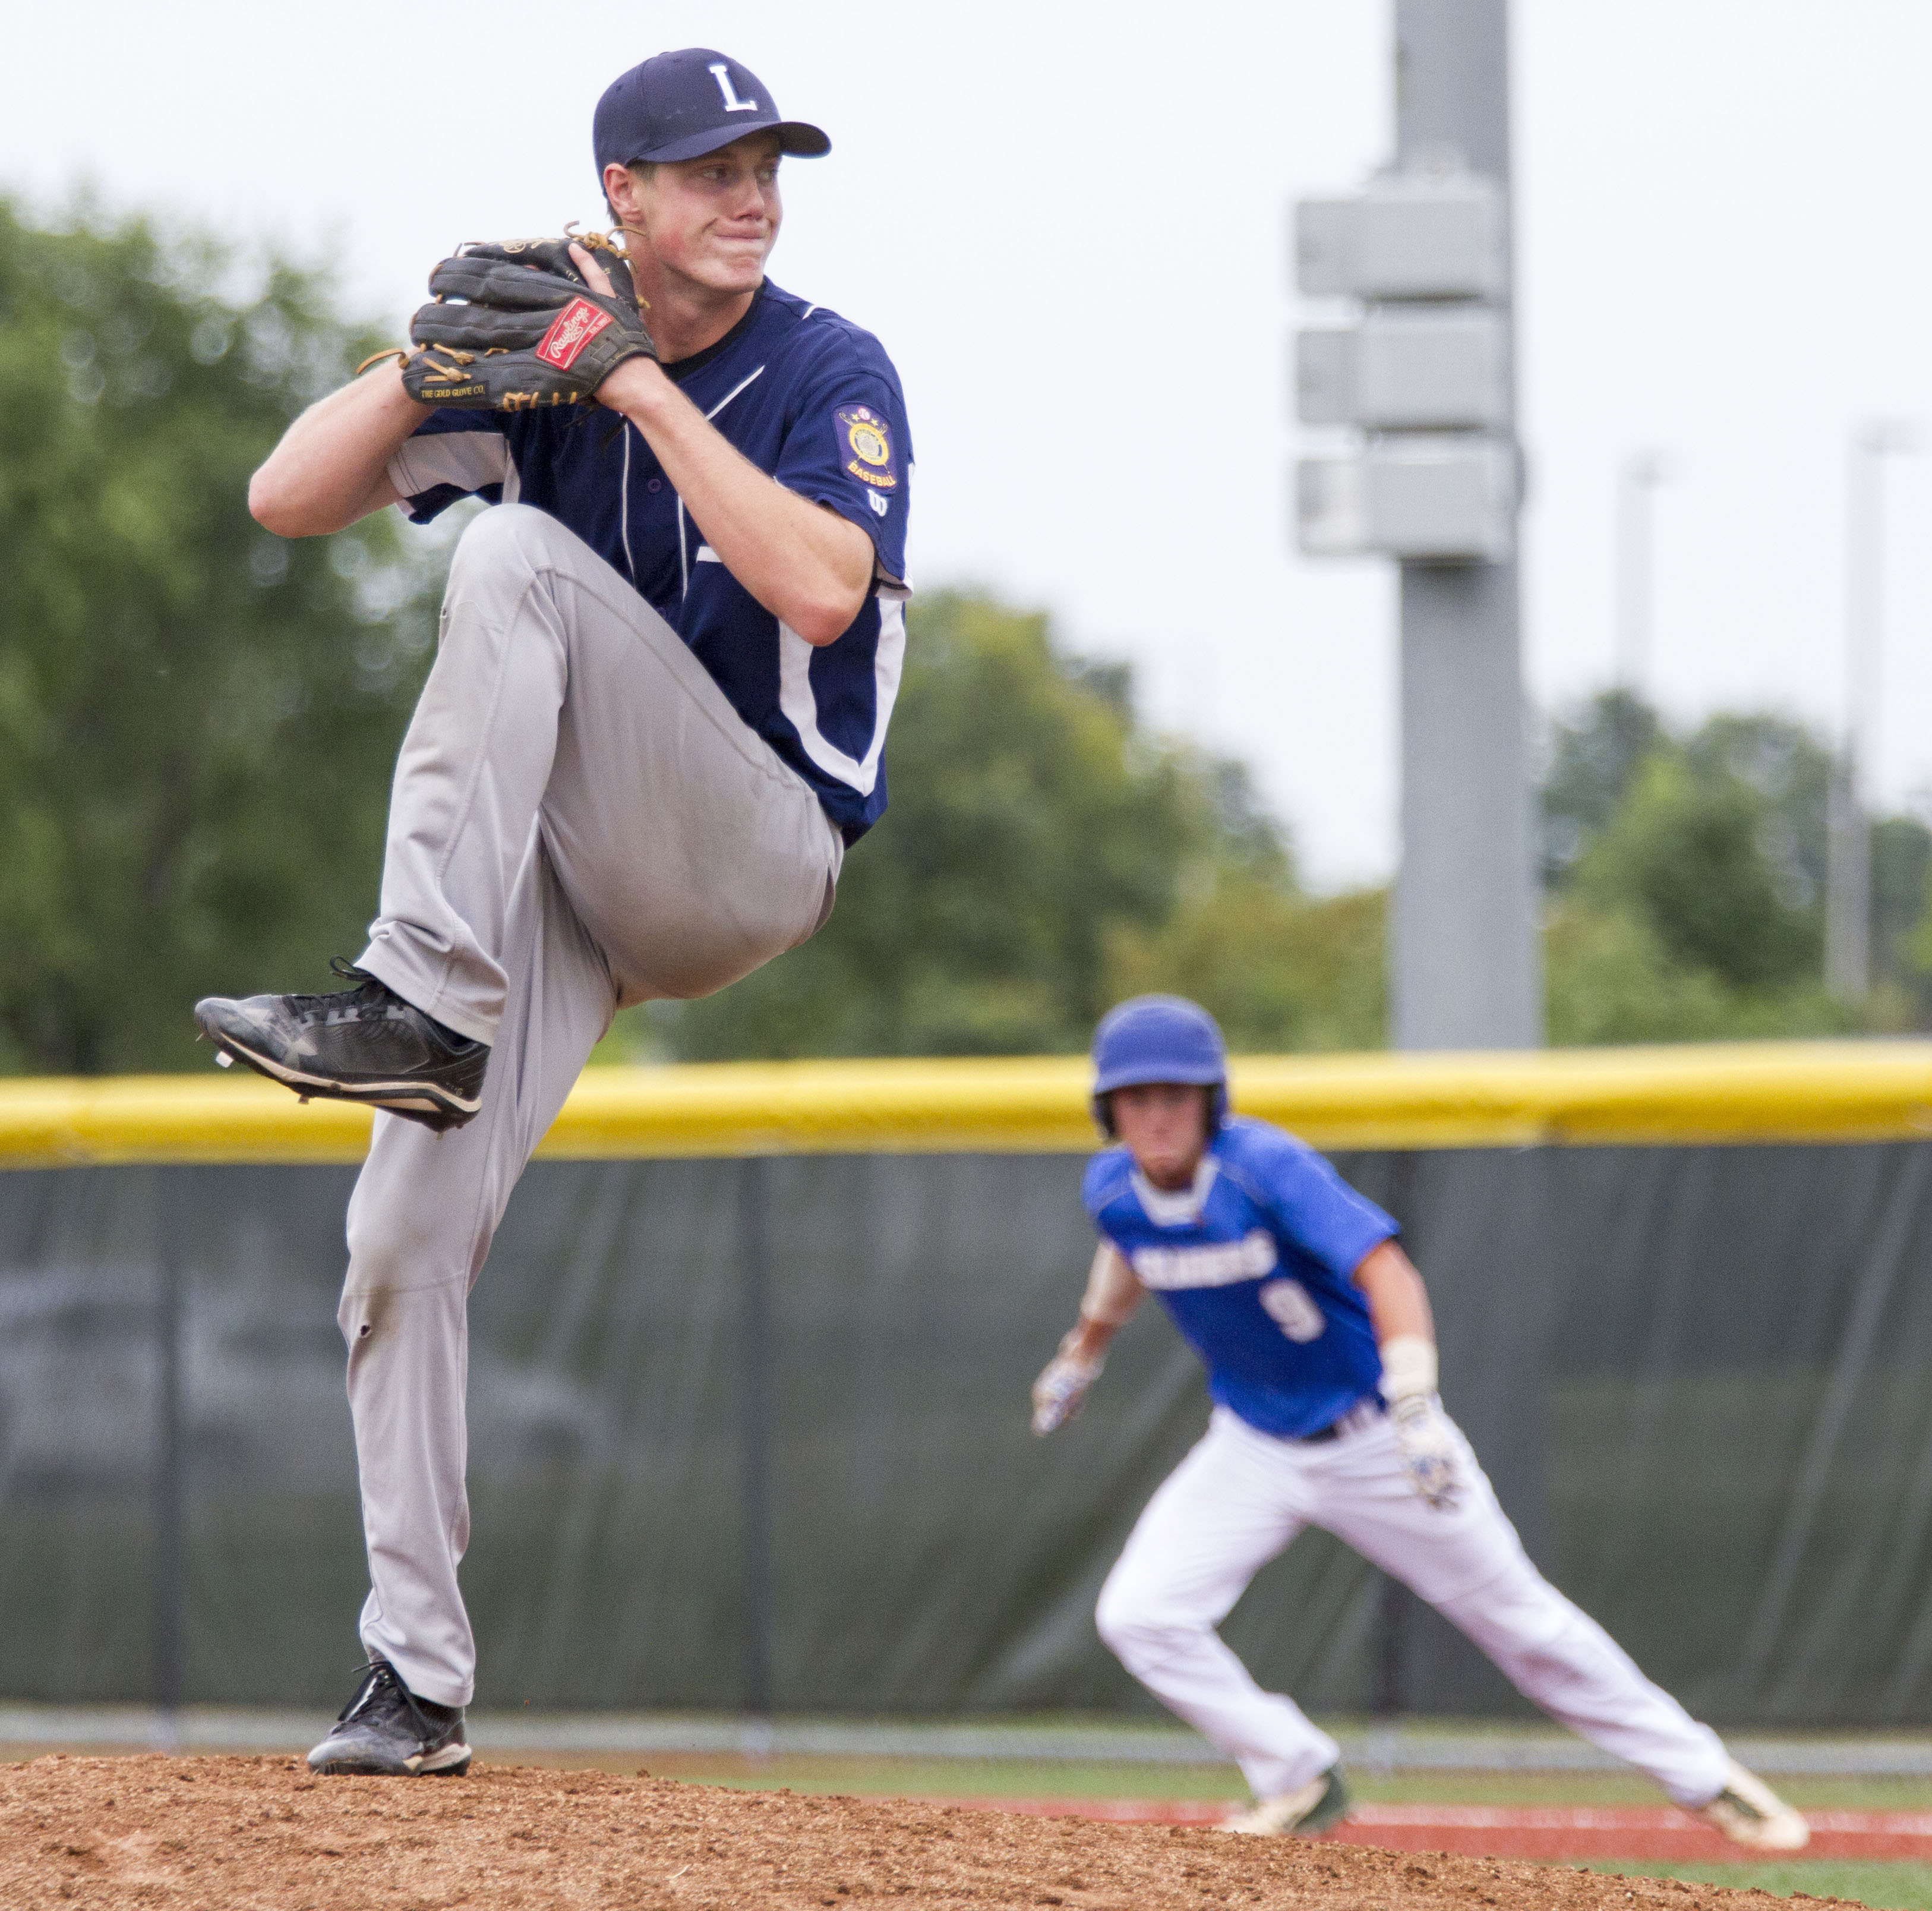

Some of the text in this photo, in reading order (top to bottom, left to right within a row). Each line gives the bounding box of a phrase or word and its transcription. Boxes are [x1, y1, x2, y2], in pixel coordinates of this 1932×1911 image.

[709, 65, 758, 112] L
[550, 307, 590, 359] Rawlings
[421, 390, 434, 399] THE
[434, 389, 450, 398] GOLD
[452, 387, 472, 397] GLOVE
[847, 461, 896, 488] BASEBALL
[1260, 1278, 1327, 1344] 9
